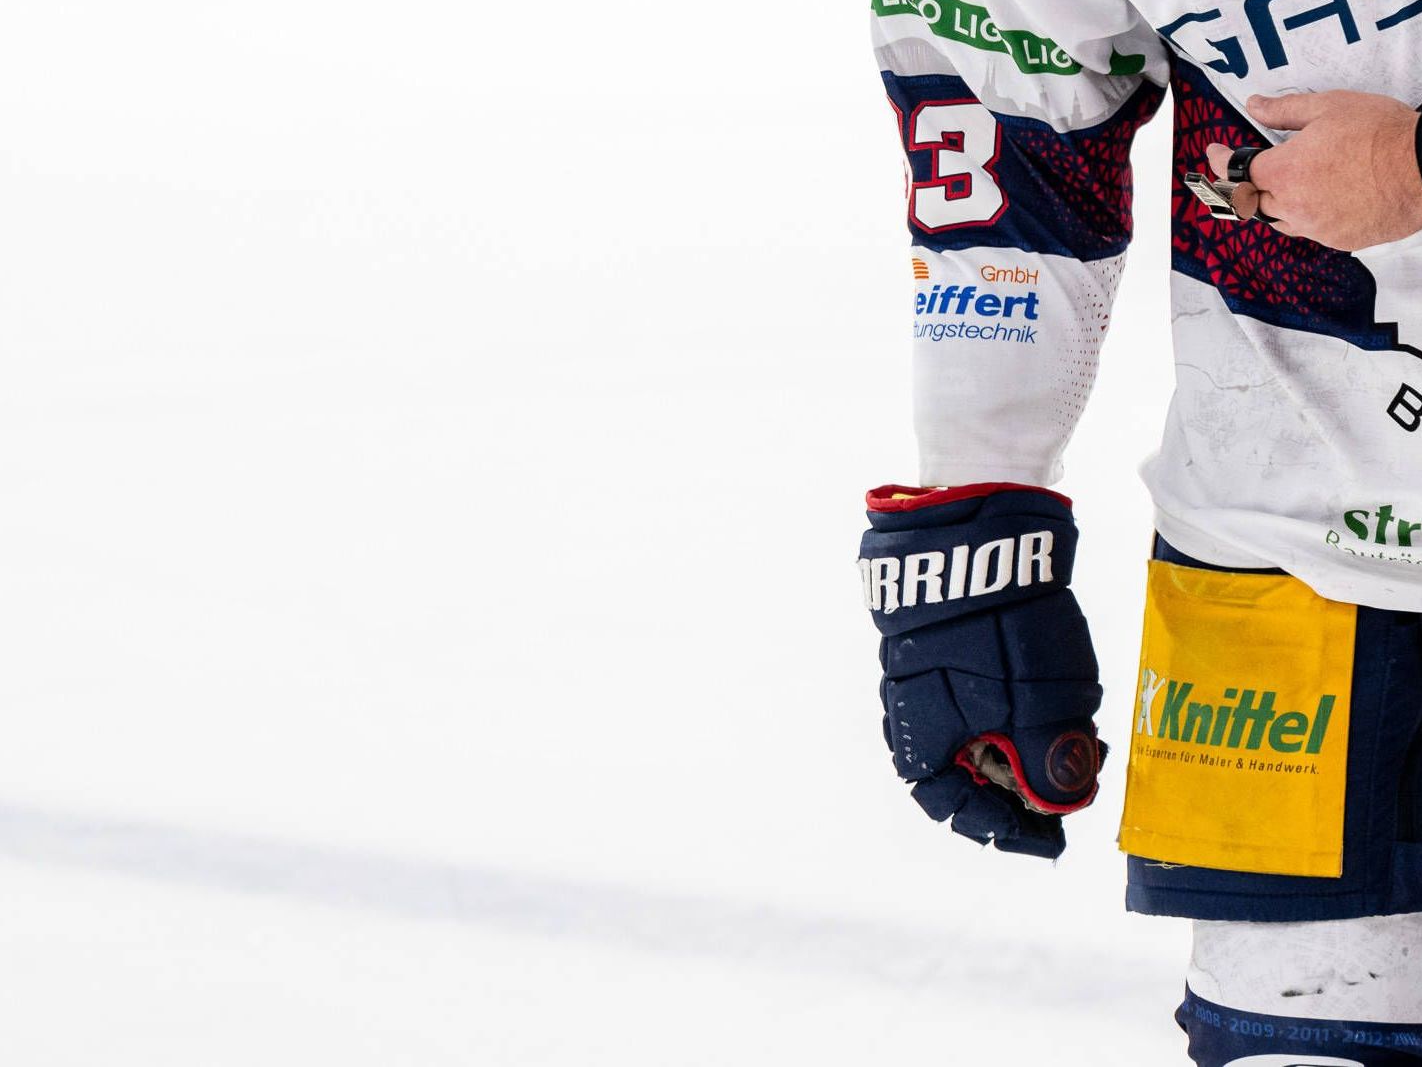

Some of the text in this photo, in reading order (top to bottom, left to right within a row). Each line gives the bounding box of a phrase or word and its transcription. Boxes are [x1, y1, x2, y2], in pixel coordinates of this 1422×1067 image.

[954, 7, 1002, 43] LIG
[1023, 39, 1075, 69] LIG
[897, 97, 1010, 234] 3
[981, 265, 1038, 284] GmbH
[1158, 680, 1336, 754] Knittel
[1180, 751, 1195, 764] für
[1236, 758, 1244, 770] &
[1229, 1018, 1274, 1037] 2009
